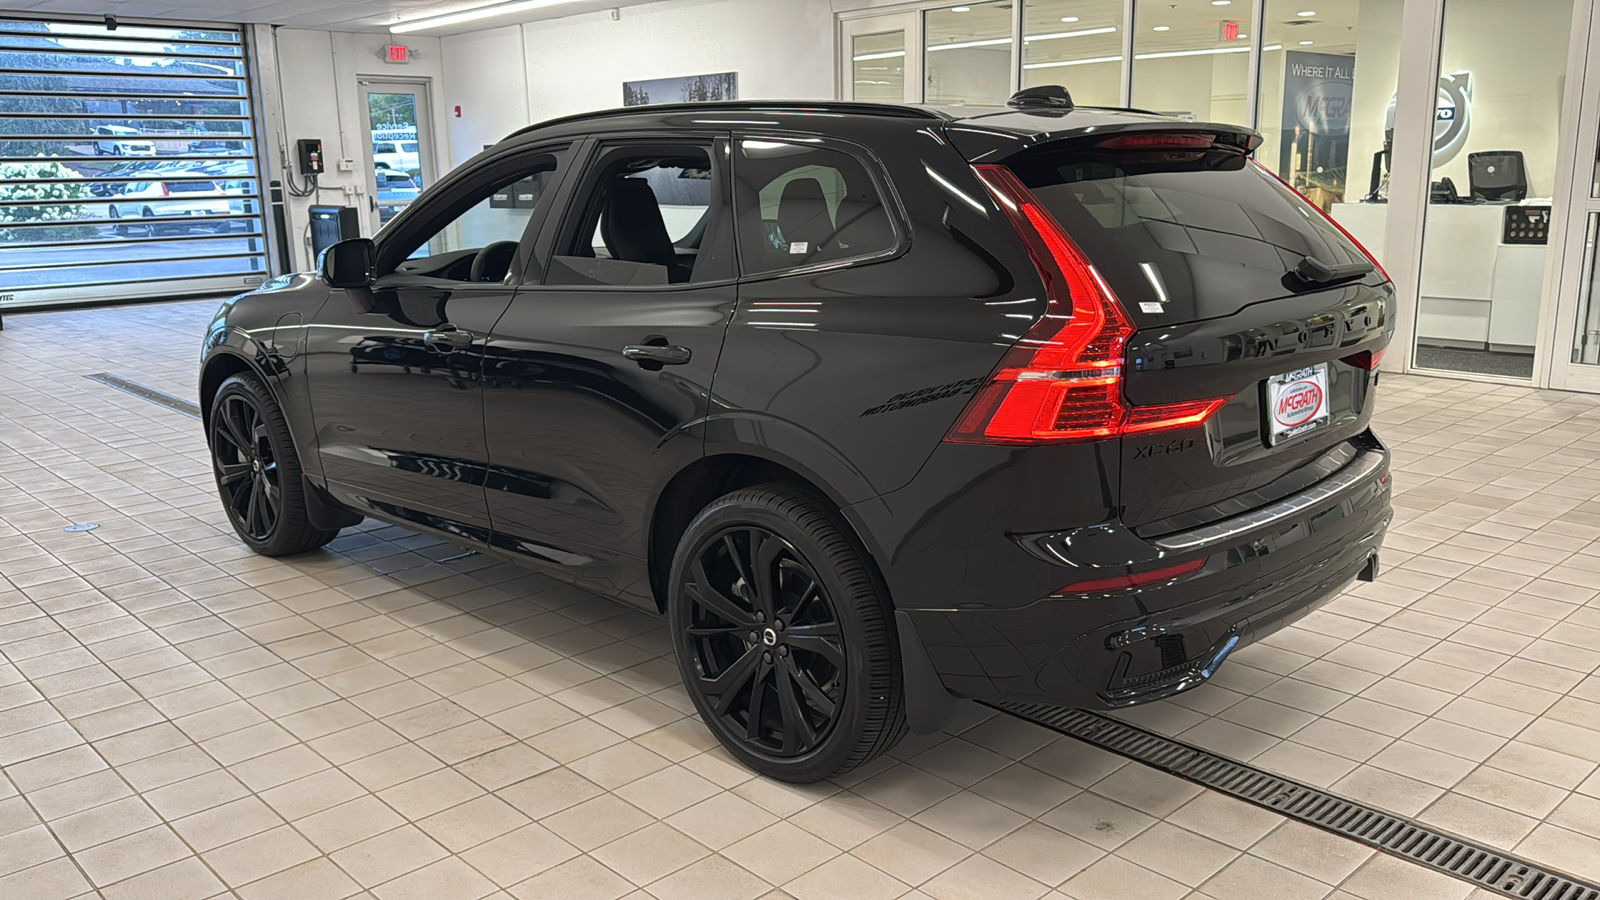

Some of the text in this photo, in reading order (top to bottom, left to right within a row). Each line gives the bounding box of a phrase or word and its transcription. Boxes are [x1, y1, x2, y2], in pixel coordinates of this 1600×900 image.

[389, 46, 406, 60] EXIT
[1278, 388, 1318, 415] McGRATH
[1133, 437, 1194, 460] XC60
